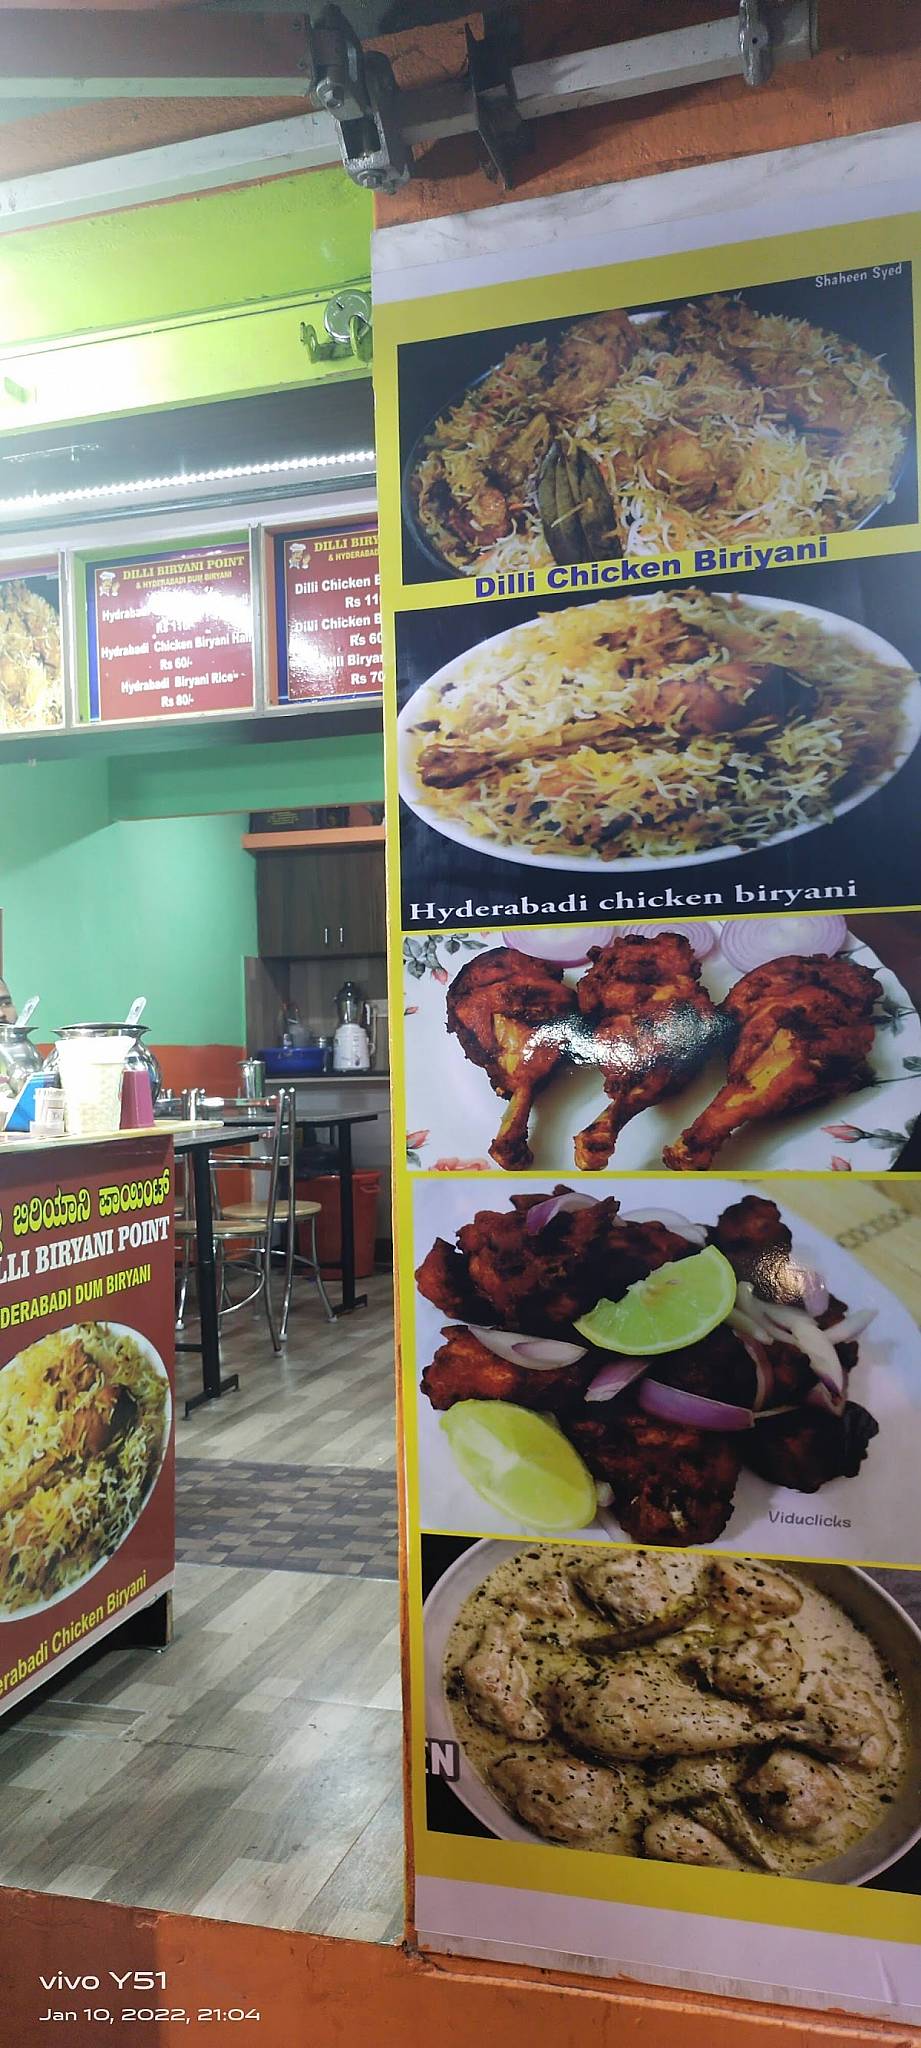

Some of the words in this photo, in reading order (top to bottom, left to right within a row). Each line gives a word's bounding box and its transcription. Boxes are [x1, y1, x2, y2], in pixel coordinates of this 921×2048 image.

[815, 271, 867, 288] Shaheen
[872, 263, 903, 280] Syed
[314, 538, 348, 552] DILLI
[123, 567, 155, 580] DILLI
[157, 561, 204, 576] BIRYANI
[206, 556, 245, 569] POINT
[475, 571, 535, 599] Dilli
[547, 557, 681, 588] Chicken
[694, 536, 828, 571] Biriyani
[295, 581, 318, 595] Dilli
[321, 576, 371, 591] Chicken
[345, 596, 361, 609] Rs
[365, 593, 380, 606] 11
[321, 616, 371, 630] Chicken
[101, 643, 149, 660] Hydrabadi
[154, 638, 193, 652] Chicken
[195, 634, 230, 649] Biryani
[350, 634, 366, 647] Rs
[160, 659, 173, 671] Rs
[175, 673, 209, 689] Biryani
[351, 674, 367, 686] Rs
[161, 696, 174, 708] Rs
[409, 891, 588, 925] Hyderabadi
[598, 886, 724, 911] chicken
[735, 880, 858, 906] biryani
[13, 1185, 91, 1236] ಬಿರಿಯಾನಿ
[99, 1168, 170, 1217] ಪಾಯಿಂಟ್
[35, 1229, 114, 1274] BIRYANI
[118, 1216, 170, 1251] POINT
[76, 1279, 103, 1305] DUM
[107, 1264, 151, 1295] BIRYANI
[768, 1510, 852, 1528] Viduclicks
[52, 1605, 104, 1653] Chicken
[107, 1570, 147, 1615] Biryani
